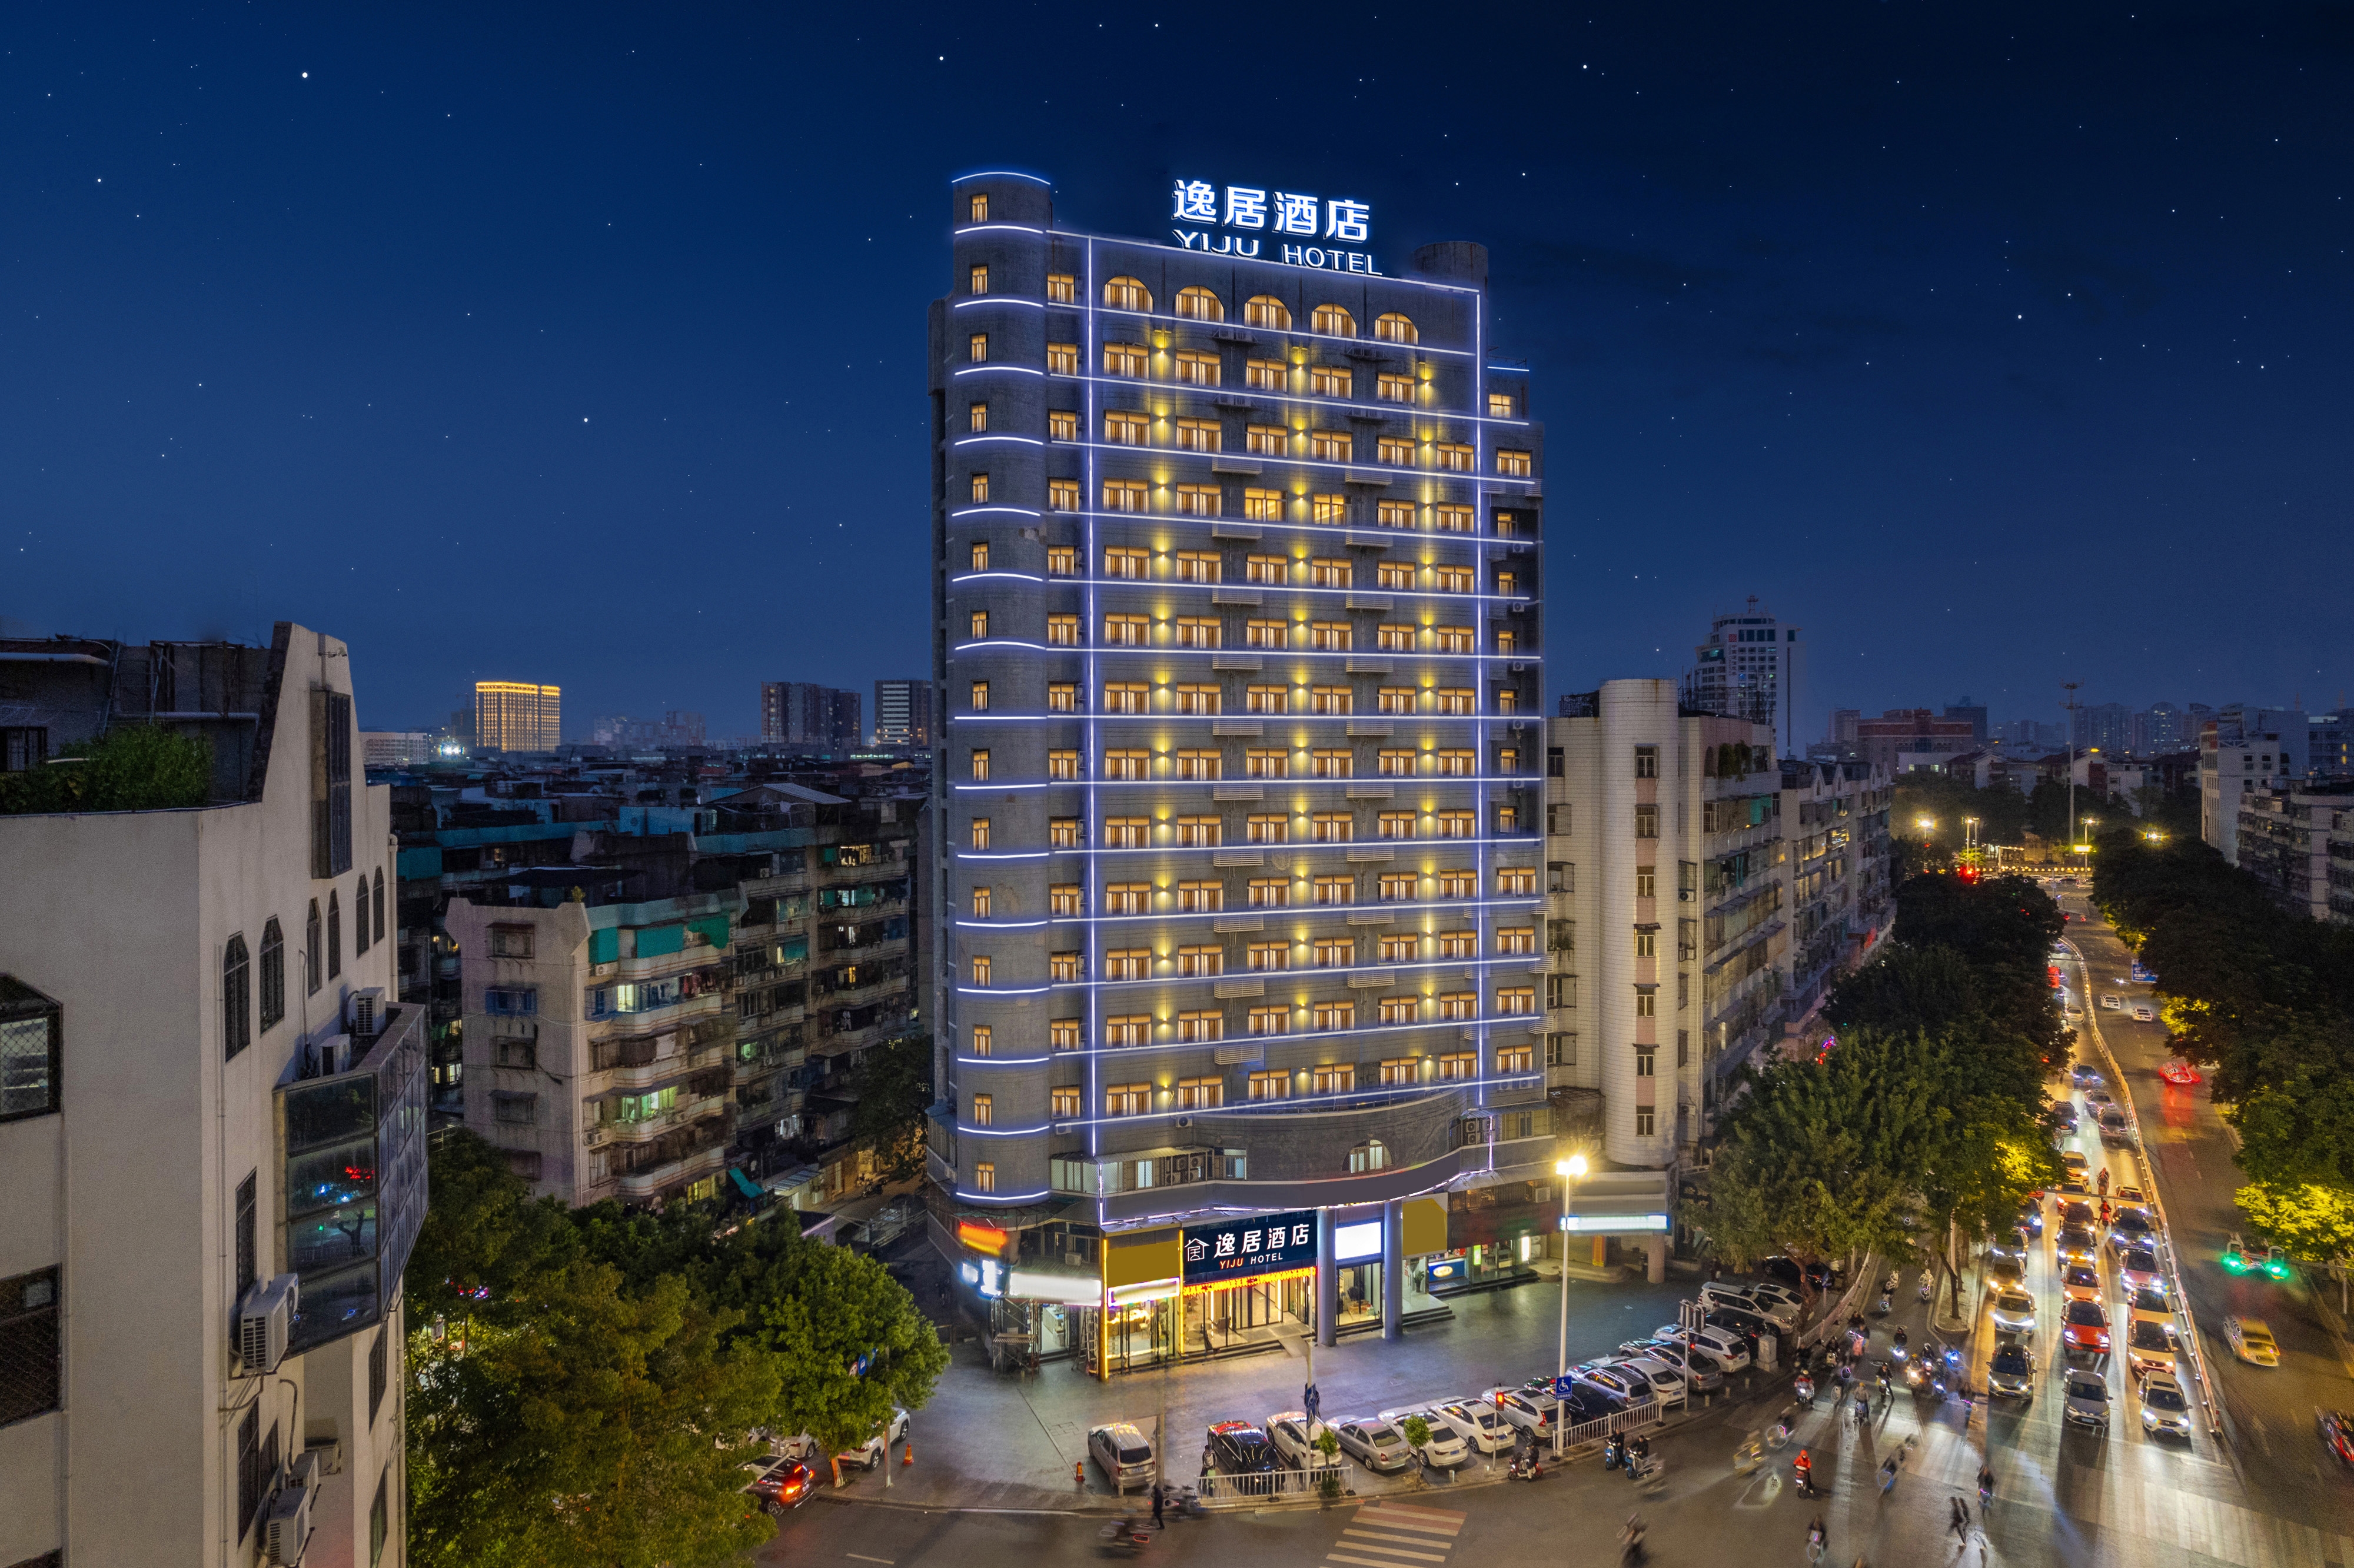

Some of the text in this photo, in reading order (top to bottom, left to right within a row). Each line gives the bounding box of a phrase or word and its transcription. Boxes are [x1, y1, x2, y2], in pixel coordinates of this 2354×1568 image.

[1172, 179, 1369, 243] 逸居酒店
[1172, 229, 1382, 275] YIJU HOTEL
[1212, 1223, 1309, 1259] 逸居酒店
[1219, 1252, 1283, 1270] YIJU HOTEL
